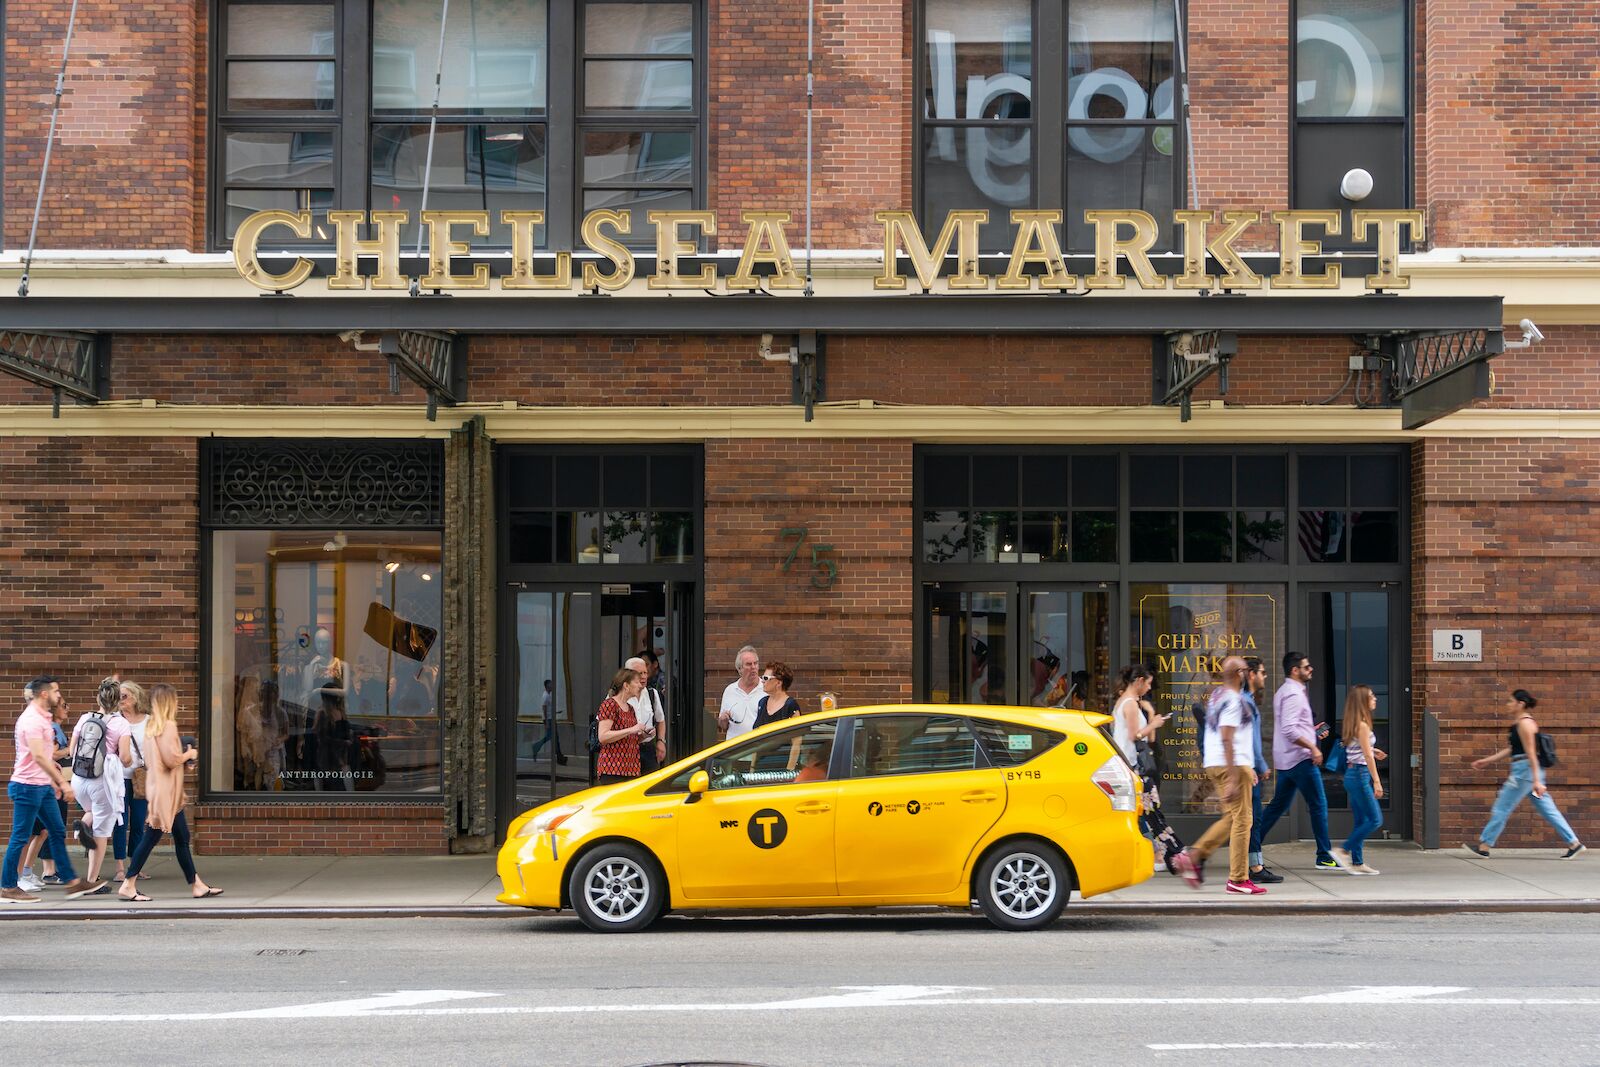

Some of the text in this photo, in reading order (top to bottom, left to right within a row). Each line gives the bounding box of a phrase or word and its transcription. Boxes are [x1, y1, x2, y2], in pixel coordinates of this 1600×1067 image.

[233, 208, 1427, 291] CHELSEA MARKET
[779, 527, 837, 588] 75
[1194, 612, 1221, 626] SHOP
[1157, 633, 1257, 650] CHELSEA
[1452, 634, 1464, 650] B
[1158, 655, 1258, 673] MARK
[279, 771, 375, 779] ANTHROPOLOGIE
[720, 816, 779, 845] NYC T
